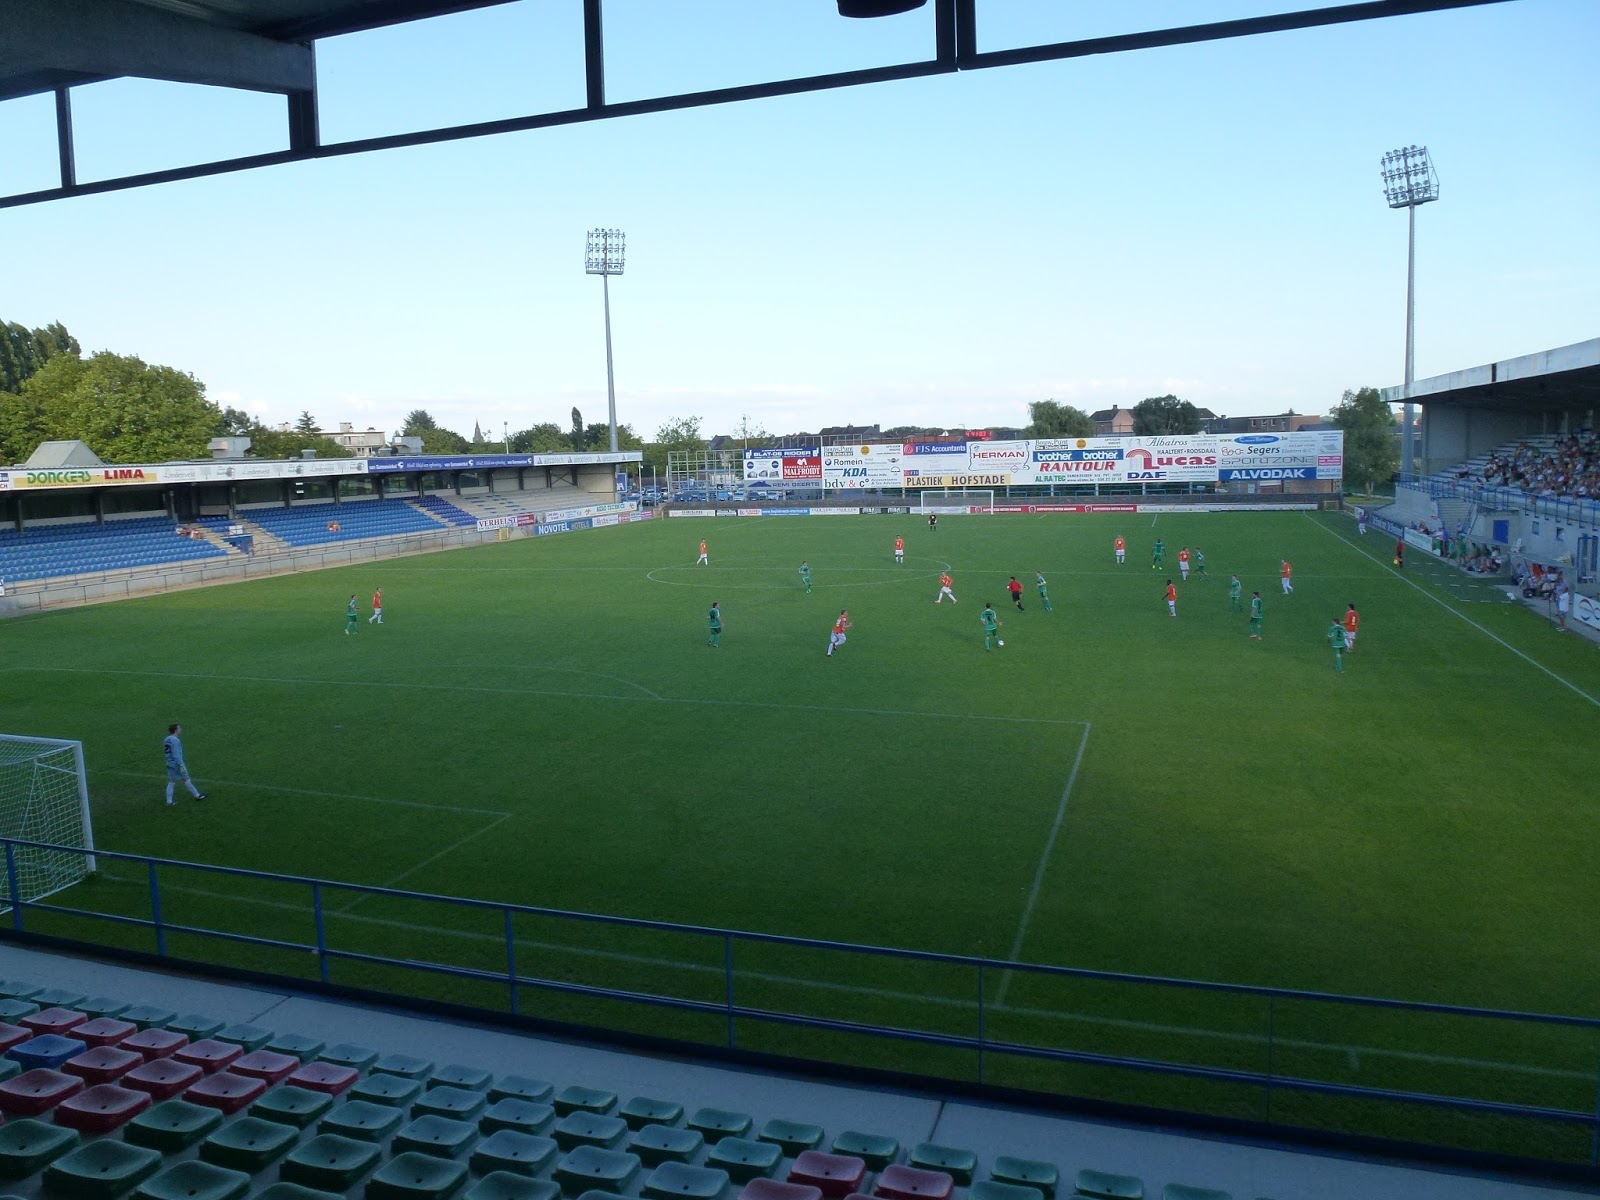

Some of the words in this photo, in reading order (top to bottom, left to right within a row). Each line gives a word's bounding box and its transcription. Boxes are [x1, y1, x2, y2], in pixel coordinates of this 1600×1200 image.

[1146, 437, 1188, 446] Albatros
[932, 444, 966, 452] Accountants
[1247, 446, 1280, 456] Segers
[973, 451, 1025, 459] HERMAN
[1037, 452, 1072, 461] brother
[1082, 451, 1118, 460] brother
[833, 458, 863, 466] Romein
[1143, 456, 1217, 469] Lucas
[1221, 456, 1314, 465] SPORTZONE
[1039, 461, 1116, 472] RANTOUR
[104, 469, 145, 480] LIMA
[784, 468, 820, 476] MALFROIDT
[842, 467, 868, 477] KDA
[1127, 471, 1167, 479] DAF
[1230, 469, 1305, 480] ALVODAK
[824, 479, 845, 488] bdv
[848, 480, 856, 488] &
[906, 476, 943, 486] PLASTIEK
[951, 475, 1005, 485] HOFSTADE
[478, 516, 517, 527] VERHELST
[572, 520, 590, 530] HOTELS
[538, 522, 570, 535] NOVOTEL
